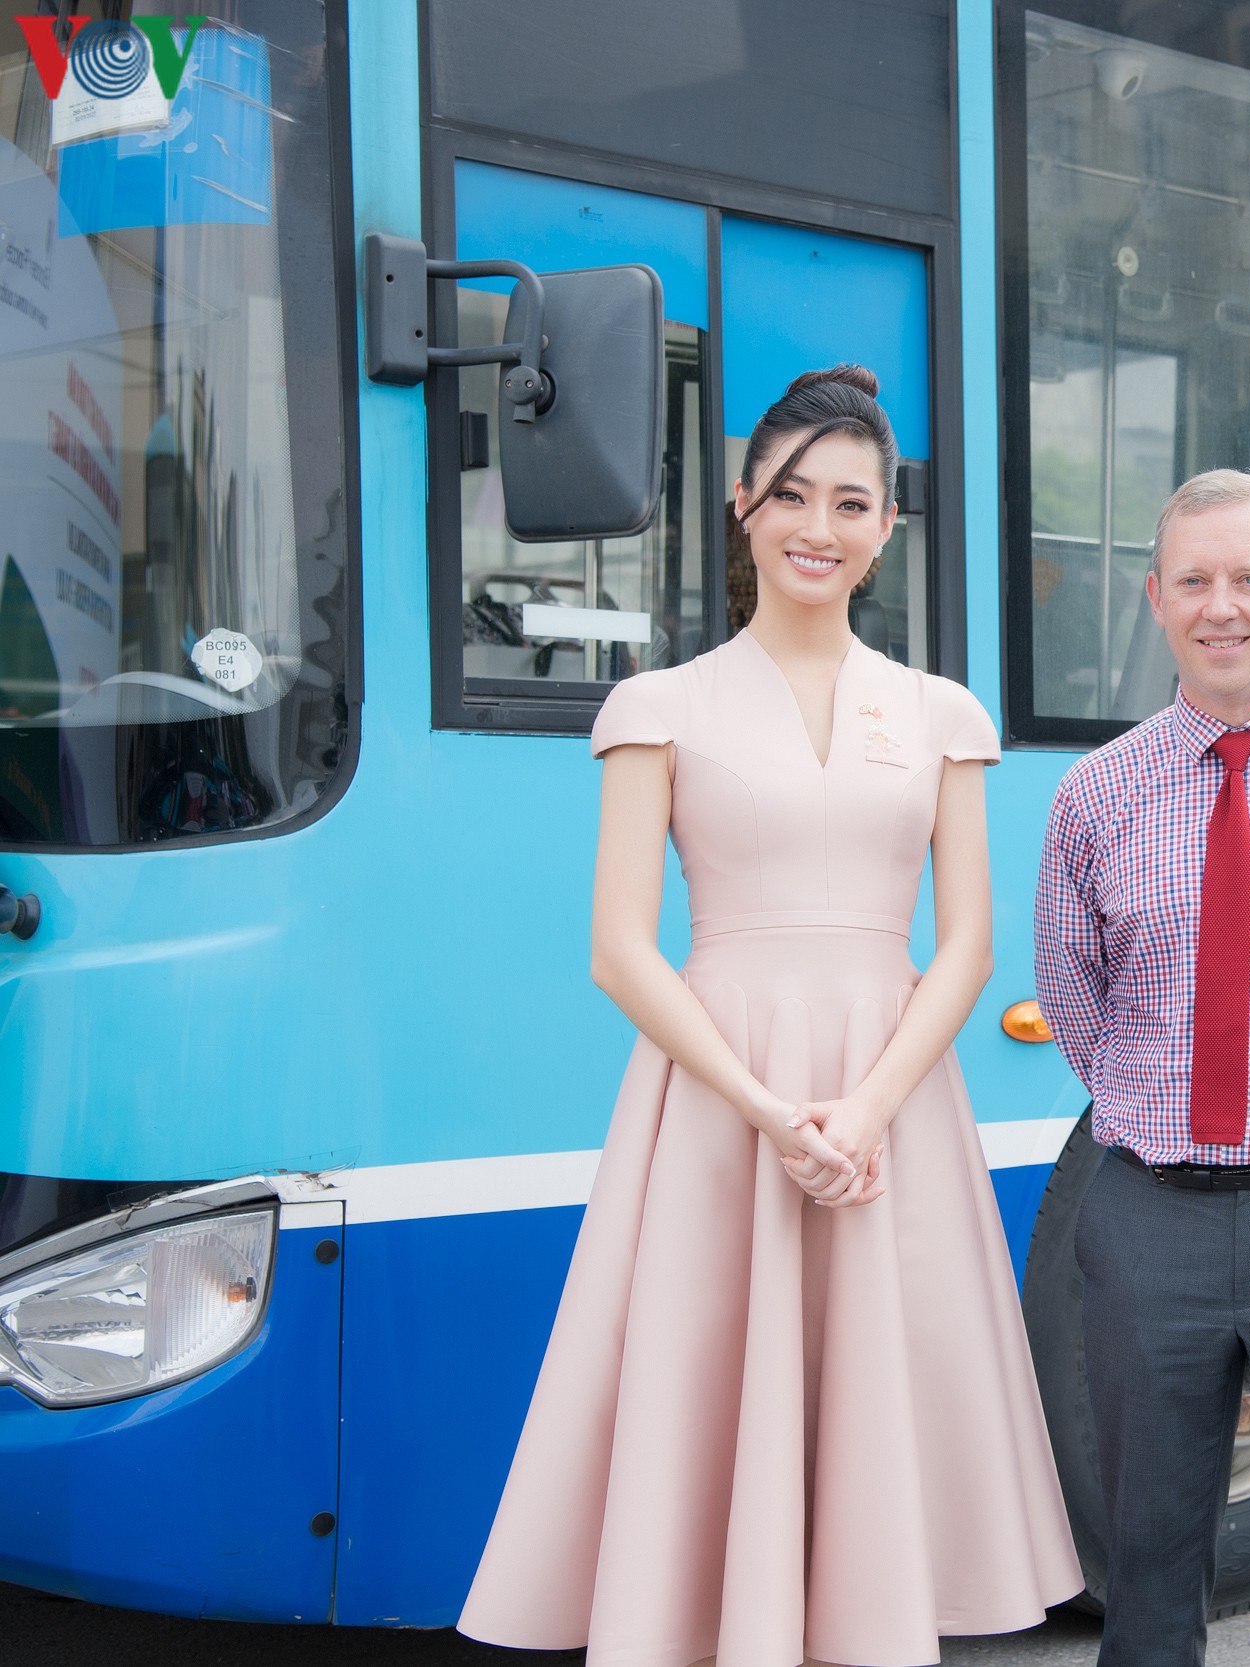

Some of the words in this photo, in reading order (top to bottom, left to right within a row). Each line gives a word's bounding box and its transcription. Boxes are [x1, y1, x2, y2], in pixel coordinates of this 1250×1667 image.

[205, 641, 247, 651] BC095
[218, 655, 234, 665] E4
[215, 669, 236, 680] 081
